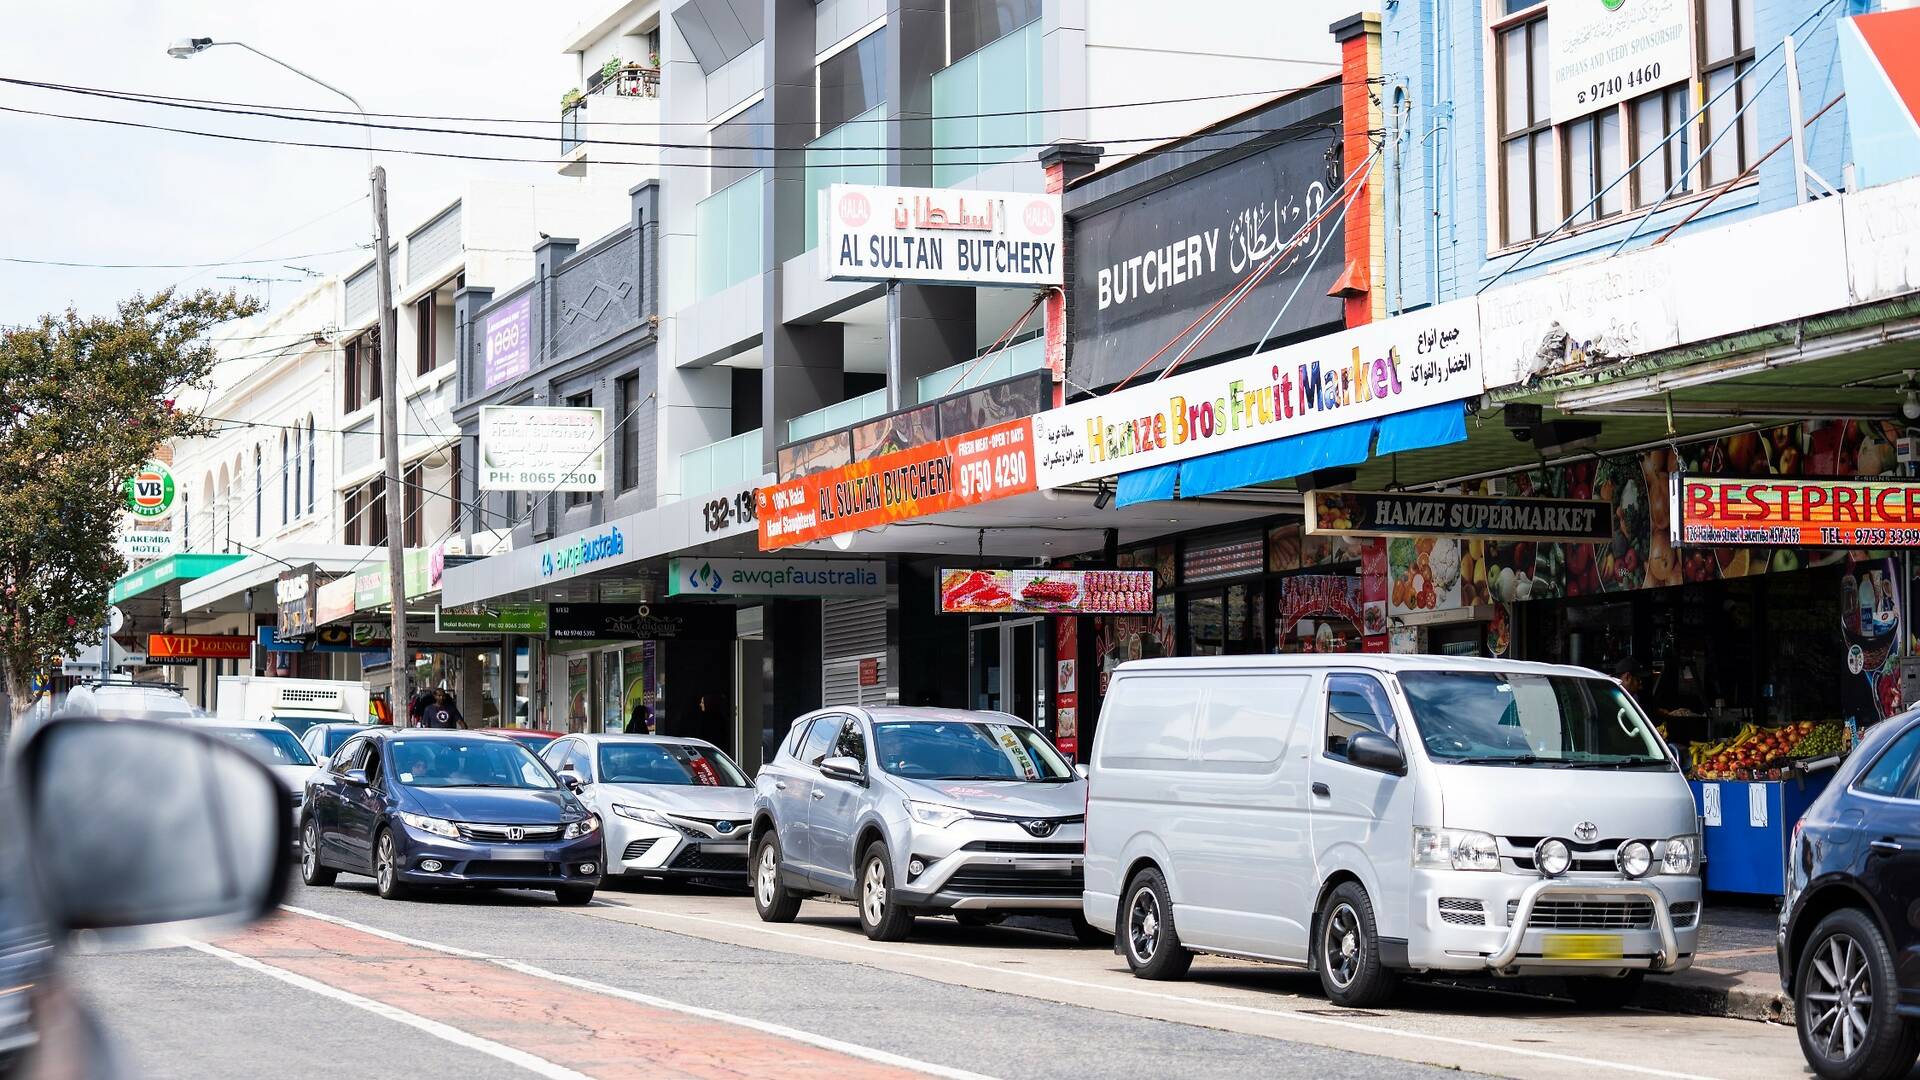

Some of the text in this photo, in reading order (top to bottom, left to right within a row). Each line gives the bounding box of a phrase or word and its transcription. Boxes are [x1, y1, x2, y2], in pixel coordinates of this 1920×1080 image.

[1556, 24, 1683, 83] ORPHANS AND NEEDY SPONSORSHIP
[1591, 62, 1661, 102] 9740 4460
[841, 199, 869, 219] HALAL
[1026, 207, 1053, 227] HALAL
[840, 234, 1055, 275] AL SULTAN BUTCHERY
[1099, 228, 1219, 310] BUTCHERY
[1440, 328, 1460, 349] جميع
[1087, 345, 1403, 464] Hamze Bros Fruit Market
[958, 441, 975, 456] FRESH
[975, 437, 989, 452] MEAT
[992, 432, 1006, 449] OPEN
[1010, 427, 1024, 443] DAYS
[489, 471, 597, 485] PH: 8065 2500
[961, 451, 1027, 497] 9750 4290
[136, 482, 162, 497] VB
[819, 455, 953, 521] AL SULTAN BUTCHERY
[132, 503, 168, 515] BITTER
[772, 490, 789, 511] 100%
[1375, 500, 1596, 532] HAMZE SUPERMARKET
[767, 517, 782, 537] Hand
[1721, 526, 1741, 542] street
[1741, 526, 1768, 543] Lakemba
[1769, 526, 1785, 543] NSW
[1854, 529, 1887, 544] 9759
[1888, 529, 1920, 544] 3399
[124, 535, 171, 544] LAKEMBA
[132, 545, 163, 553] HOTEL
[732, 566, 878, 588] awqafaustralia
[162, 637, 248, 655] VIP LOUNGE
